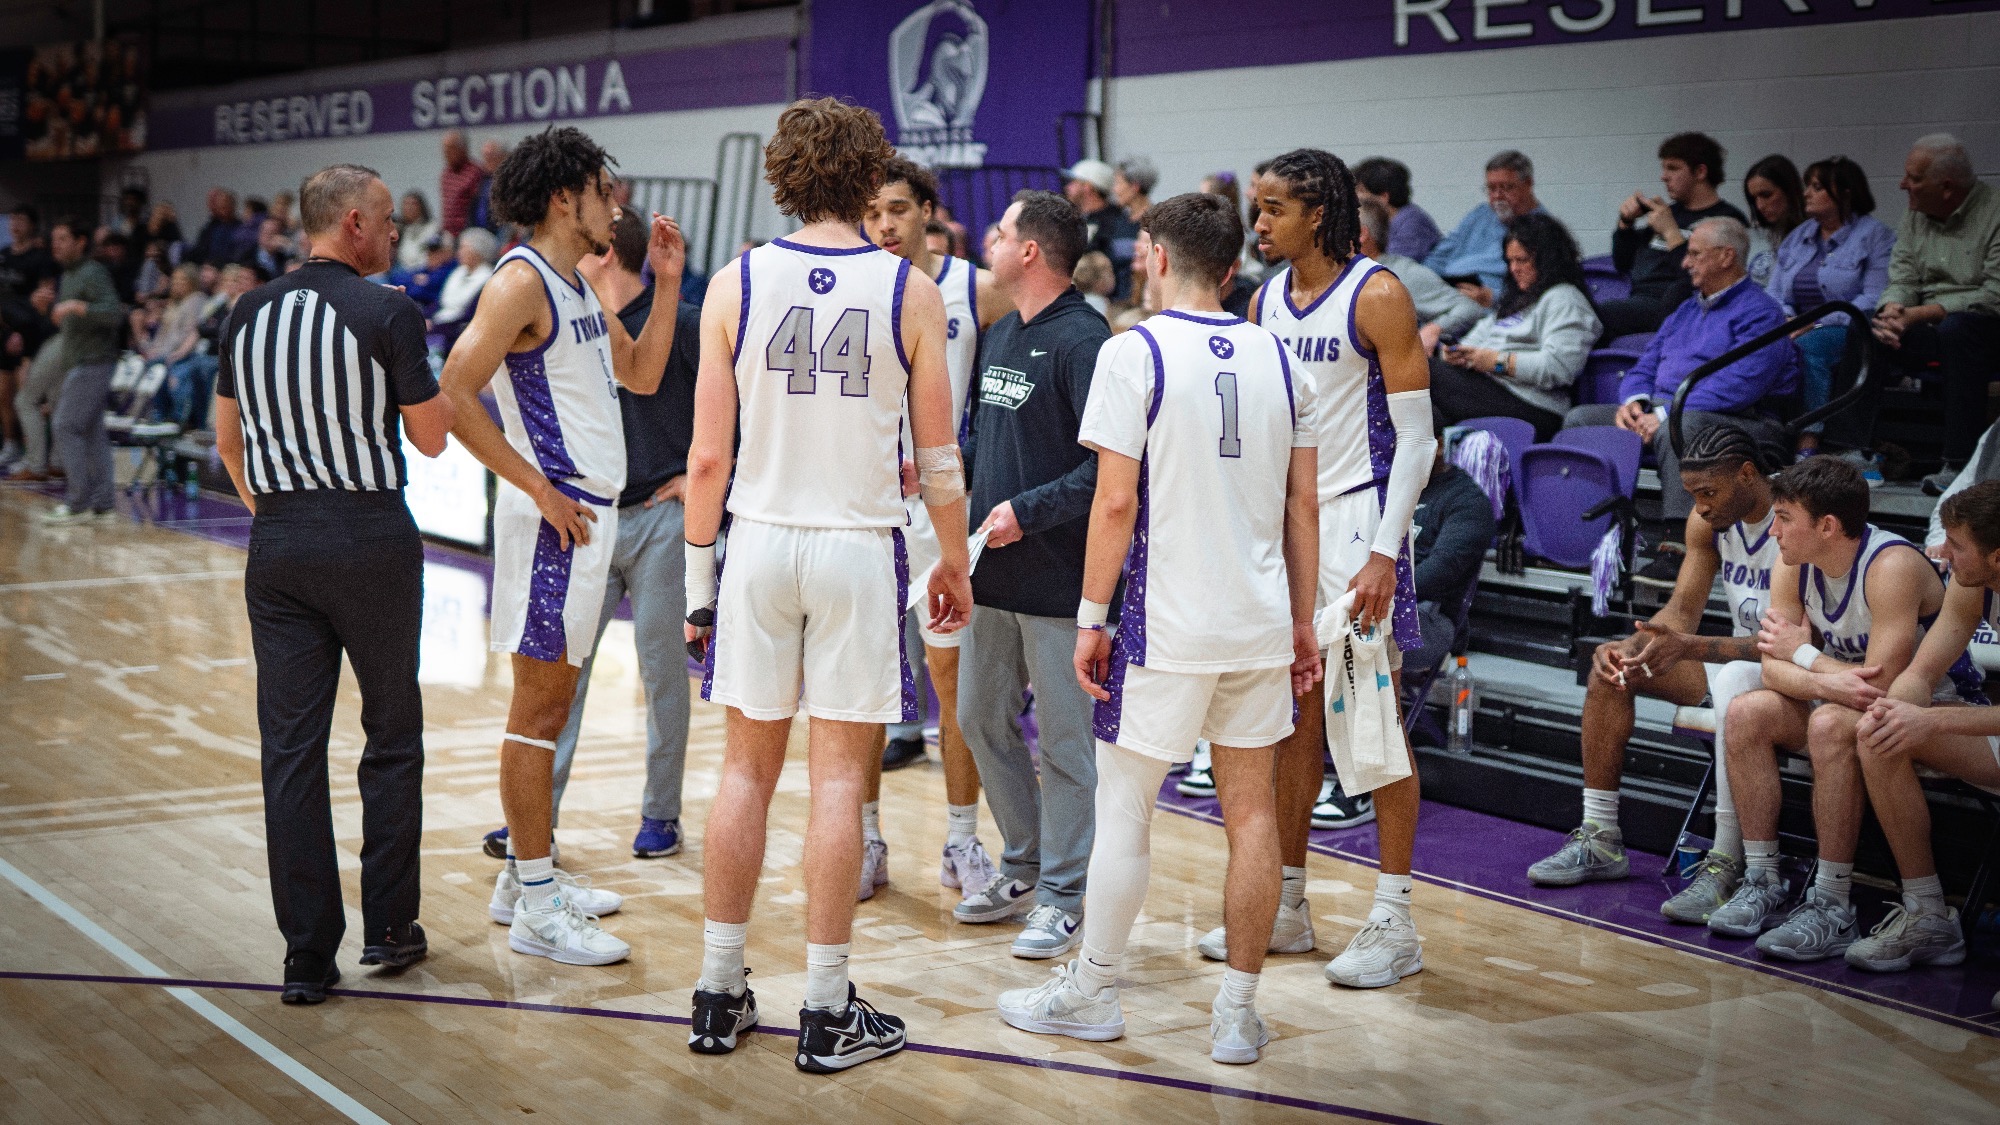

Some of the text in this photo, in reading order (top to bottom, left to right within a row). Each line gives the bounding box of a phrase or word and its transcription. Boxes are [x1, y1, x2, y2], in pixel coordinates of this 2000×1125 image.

[213, 60, 632, 143] RESERVED SECTION A
[765, 305, 872, 397] 44
[1283, 336, 1341, 362] JANS
[1214, 371, 1242, 459] 1
